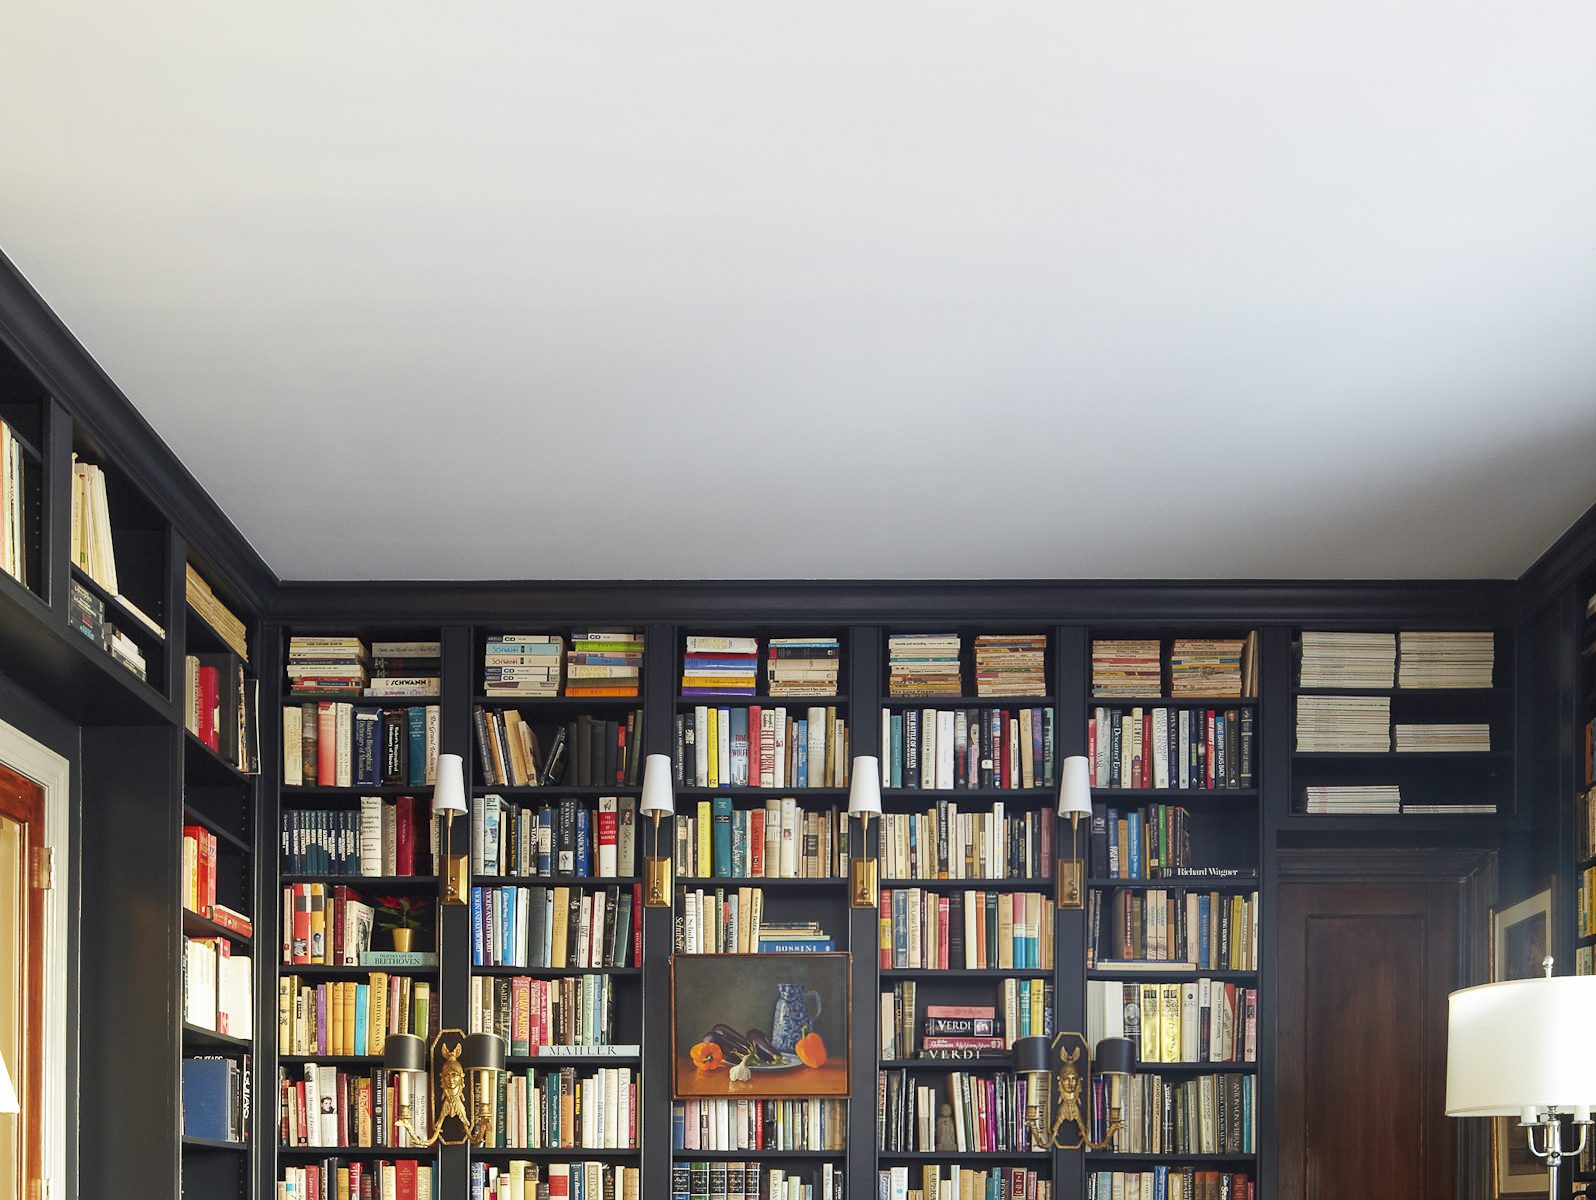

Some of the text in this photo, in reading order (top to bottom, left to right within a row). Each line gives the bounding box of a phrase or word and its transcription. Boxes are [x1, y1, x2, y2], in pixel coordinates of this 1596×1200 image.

[1134, 727, 1142, 745] SWEET
[760, 753, 775, 774] PRINT
[577, 831, 585, 862] NABOKOV
[1177, 867, 1238, 877] Richard Wagner
[675, 916, 684, 949] Schubert
[500, 982, 508, 1011] MAHLER
[483, 1009, 491, 1033] MAHLE
[518, 988, 529, 1039] GUSTAV MAHLER
[938, 1020, 970, 1031] VERDI
[550, 1046, 617, 1056] MAHLER
[929, 1049, 980, 1060] VERDI
